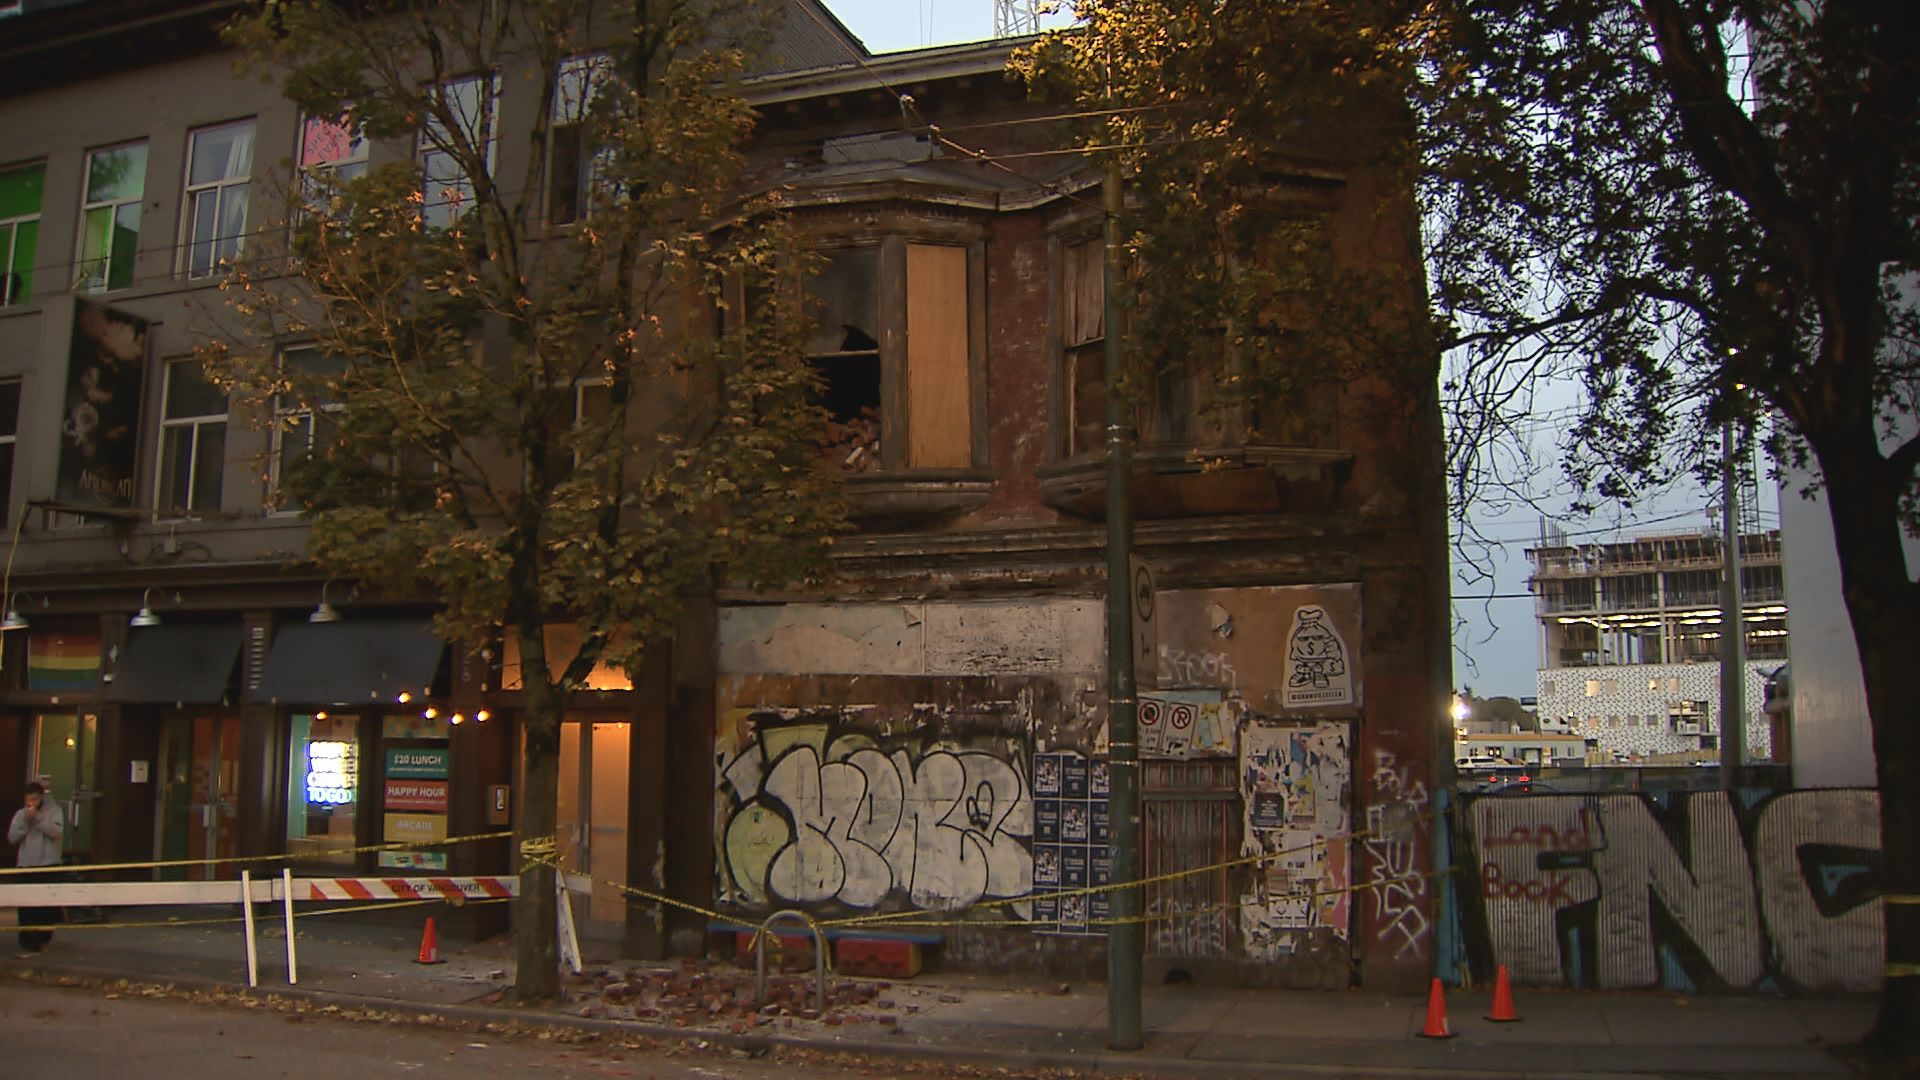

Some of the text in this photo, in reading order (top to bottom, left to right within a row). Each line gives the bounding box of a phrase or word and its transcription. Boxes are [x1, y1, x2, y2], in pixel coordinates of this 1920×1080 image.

[393, 754, 442, 766] $20 LUNCH
[387, 786, 446, 797] HAPPY HOUR
[414, 884, 426, 893] OF
